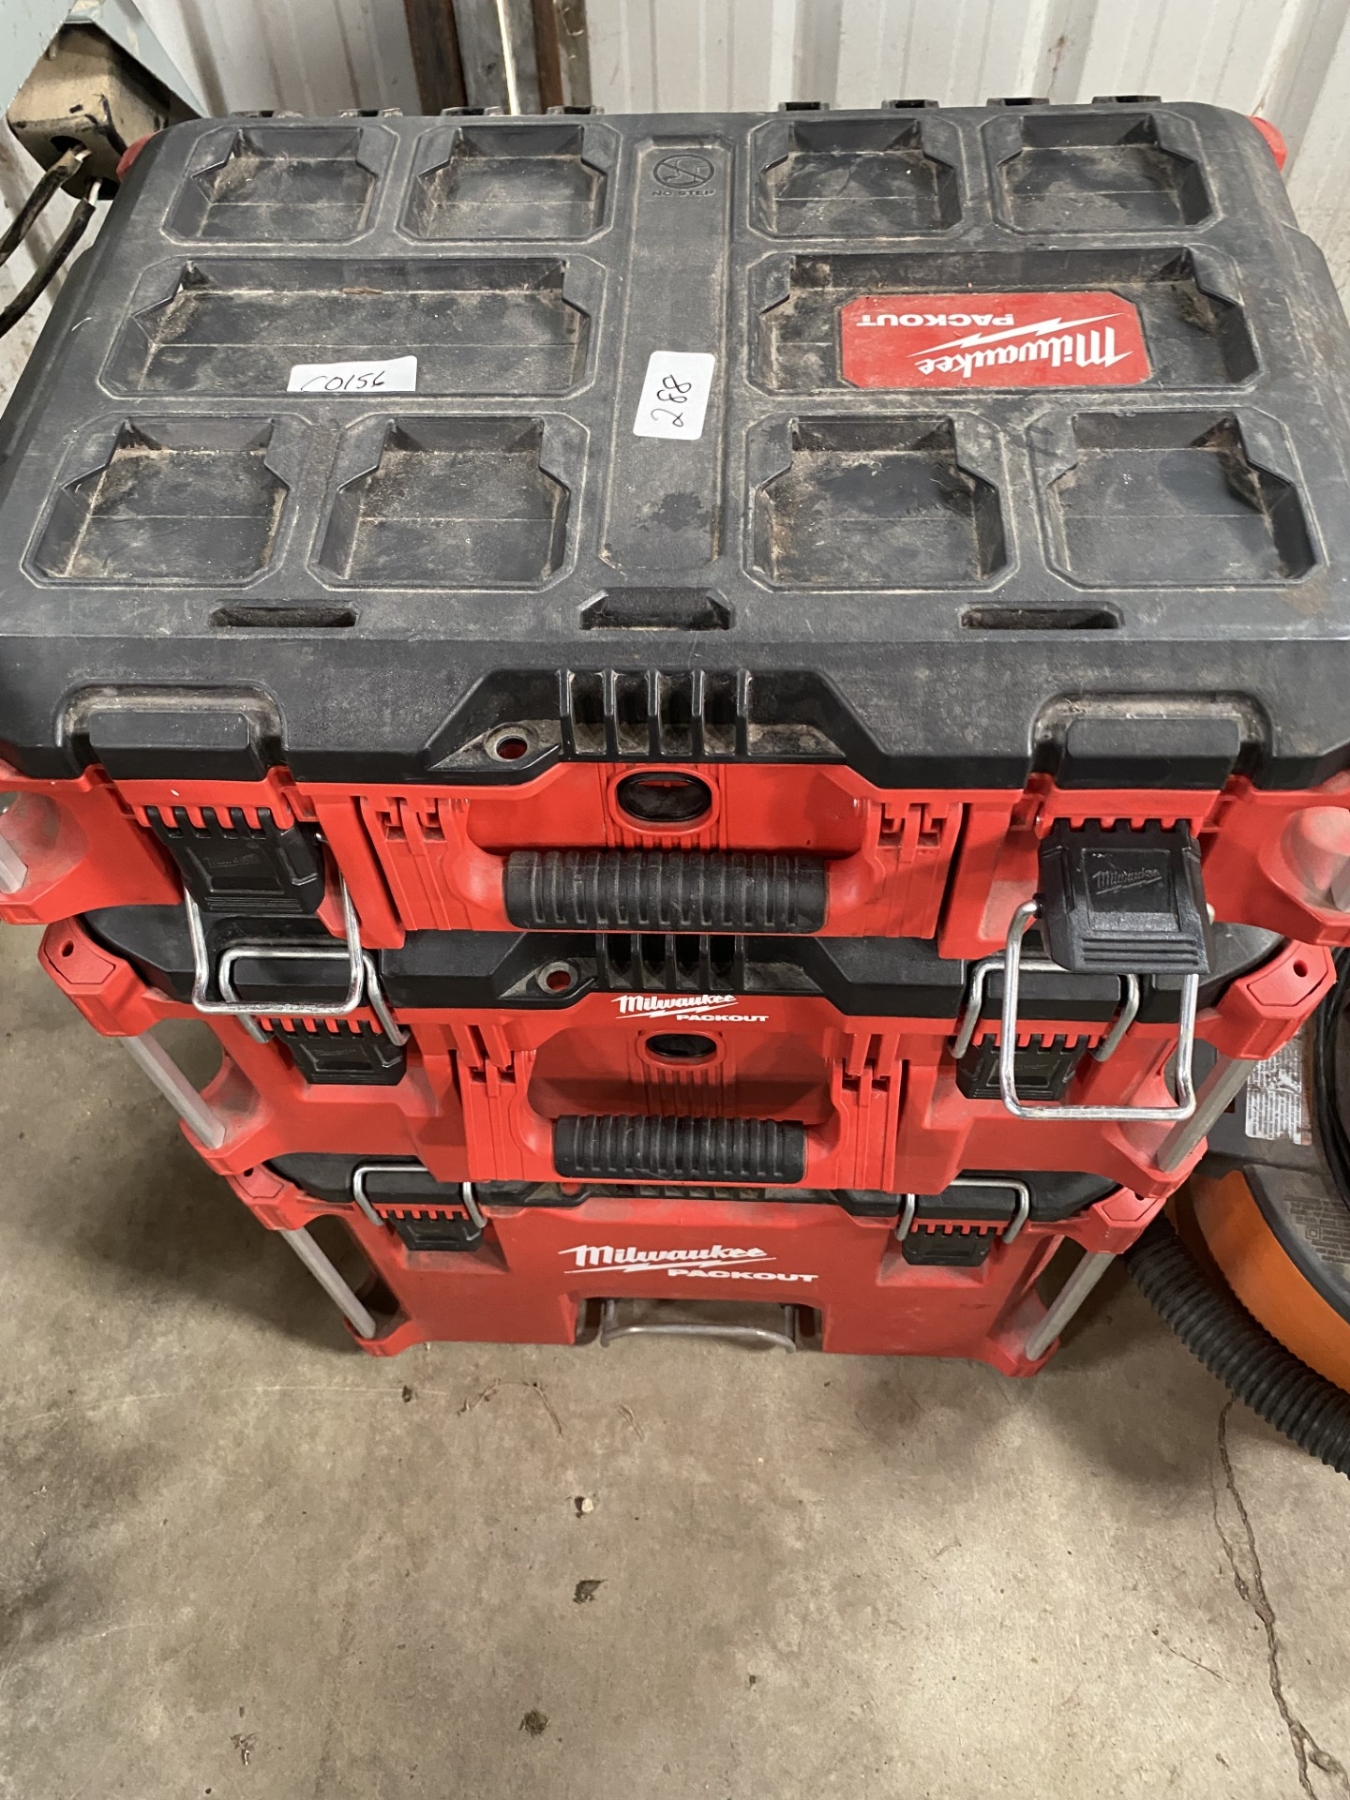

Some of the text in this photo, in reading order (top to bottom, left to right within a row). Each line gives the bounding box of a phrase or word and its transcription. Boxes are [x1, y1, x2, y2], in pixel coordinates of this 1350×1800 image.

[856, 313, 1015, 328] PACKOUT
[915, 326, 1133, 379] Milwaukee
[650, 374, 692, 428] 288
[611, 994, 737, 1014] Milwaukee
[676, 1014, 769, 1022] PACKOUT
[558, 1244, 767, 1267] Milwaukee
[667, 1268, 819, 1282] PACKOUT
